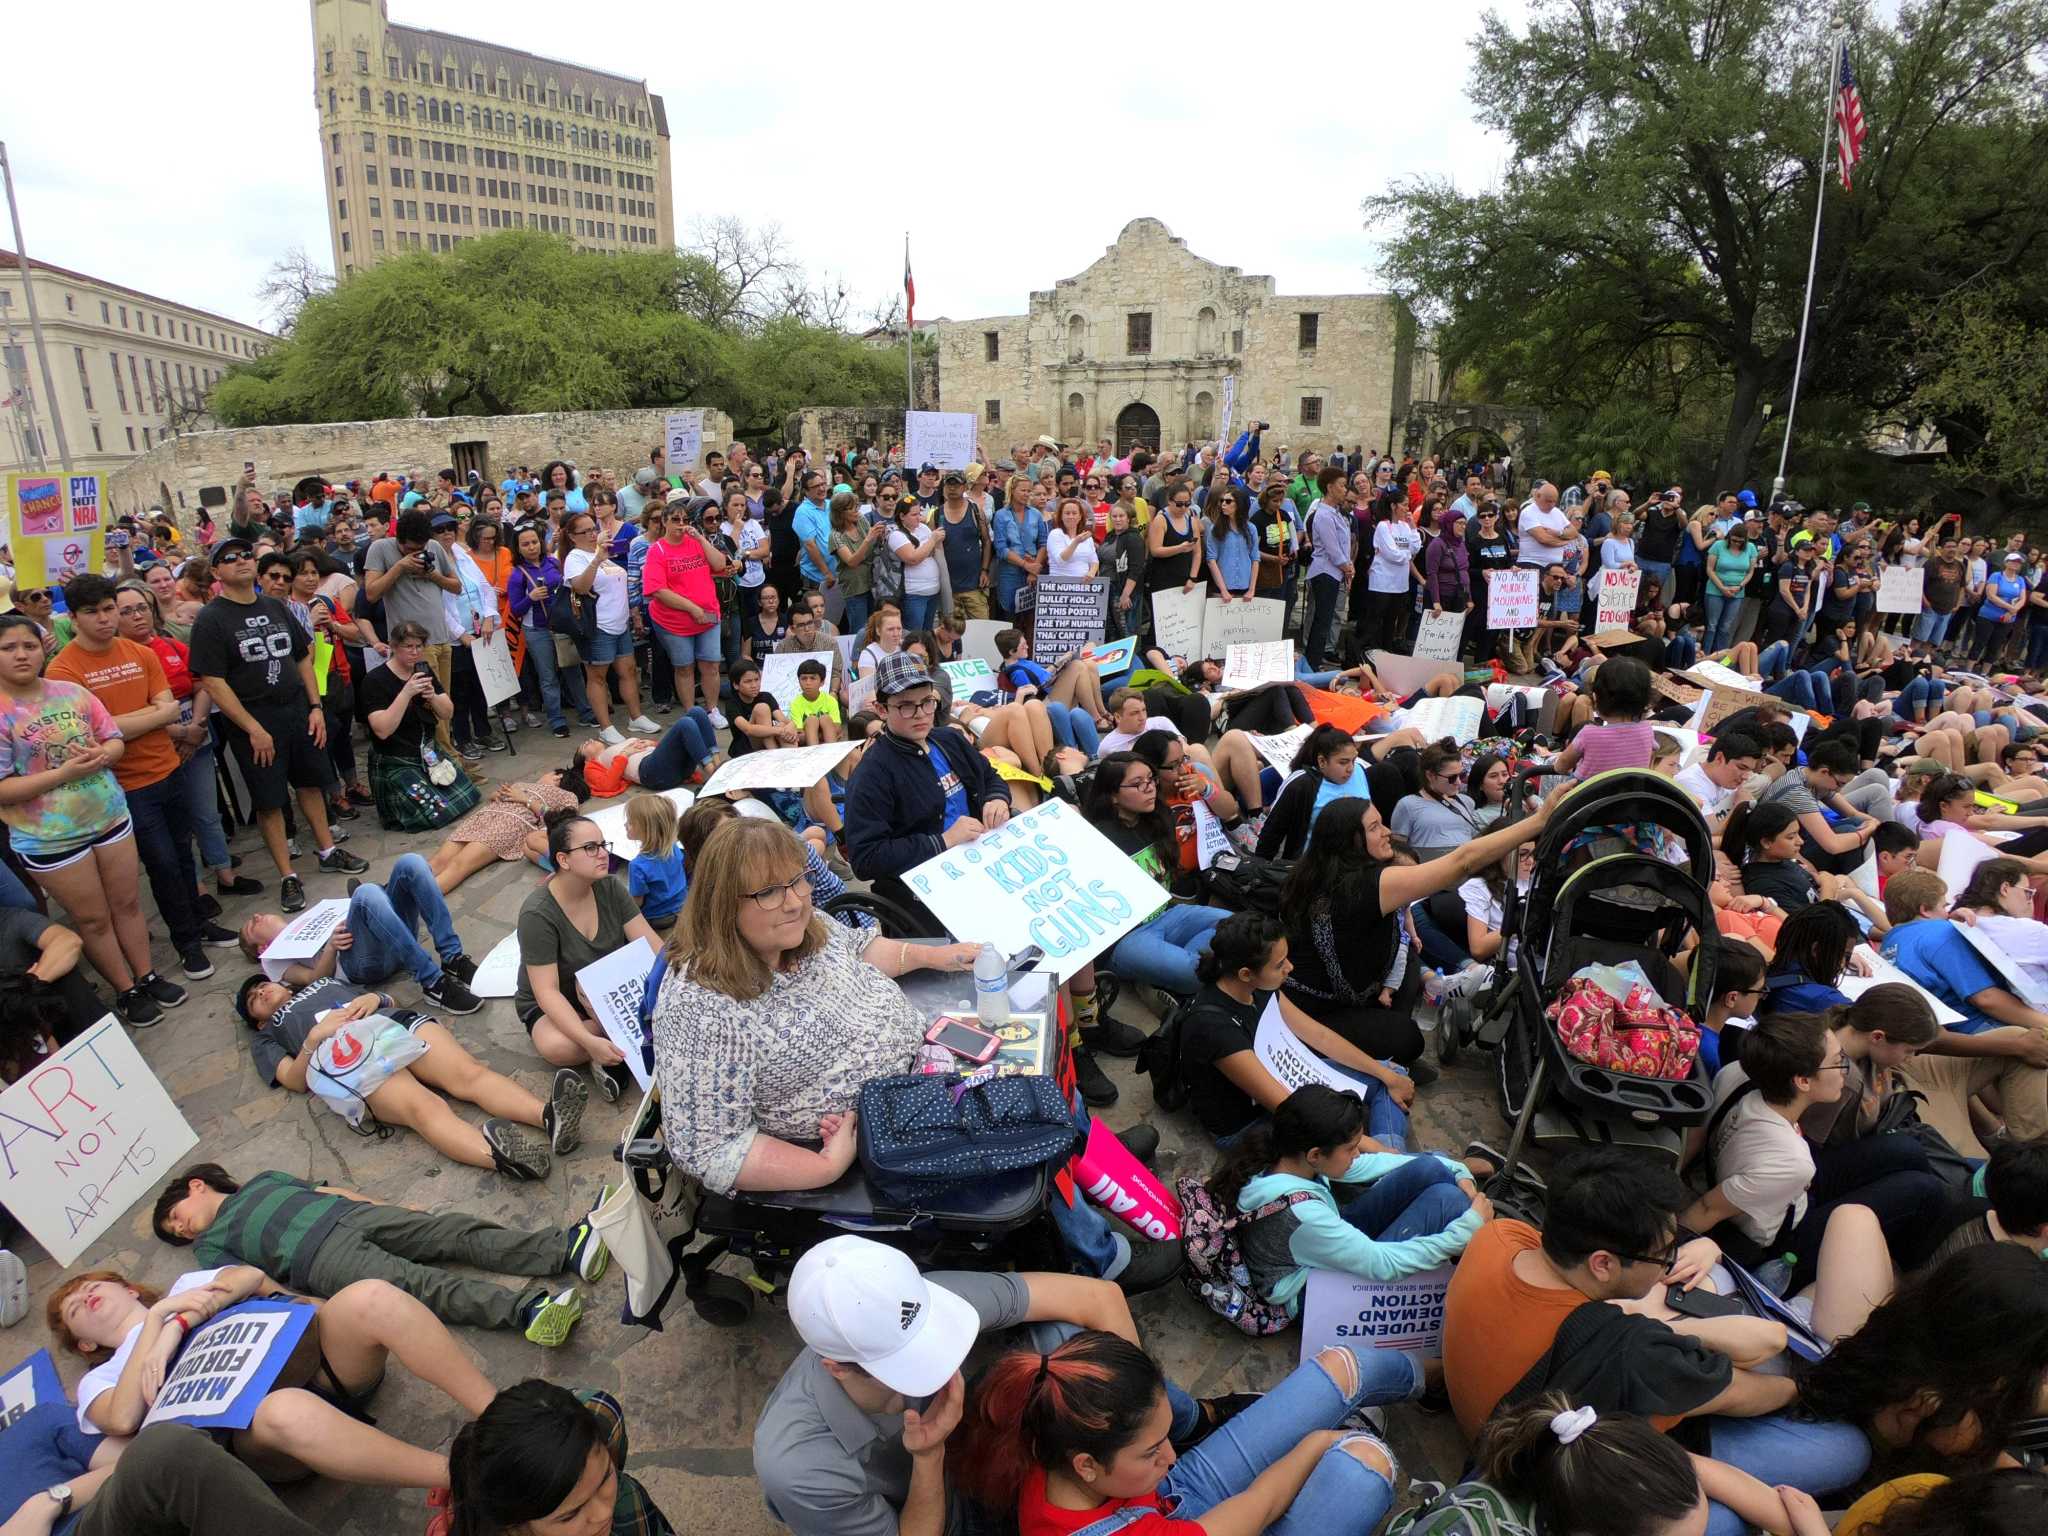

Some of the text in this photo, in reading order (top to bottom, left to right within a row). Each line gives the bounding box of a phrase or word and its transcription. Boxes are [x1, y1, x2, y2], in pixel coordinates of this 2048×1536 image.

[70, 476, 97, 497] PTA
[72, 496, 97, 506] NOT
[73, 506, 97, 526] NRA
[1495, 572, 1530, 581] NO MORE
[1605, 571, 1617, 586] NO
[1040, 583, 1103, 592] THE NUMBER OF
[1499, 583, 1527, 592] MURDER
[1039, 595, 1095, 604] BULLET HOLES
[1493, 595, 1534, 606] MOURNING
[1038, 607, 1098, 616] IN THIS POSTER
[1216, 604, 1272, 616] THOUGHTS
[1506, 608, 1519, 617] AND
[1600, 610, 1615, 623] END
[245, 615, 270, 628] GO
[1037, 619, 1104, 628] ARE THE NUMBER
[1492, 616, 1534, 627] MOVING ON
[234, 623, 289, 640] SPURS
[1037, 631, 1086, 640] THAT CAN BE
[239, 632, 292, 662] GO
[1035, 643, 1057, 651] SHOT
[1058, 643, 1068, 651] IN
[1035, 655, 1054, 663] TIME
[912, 802, 1061, 895] PROTECT
[985, 833, 1069, 894] KIDS
[1022, 868, 1076, 913] NOT
[1029, 879, 1132, 959] GUNS
[608, 990, 643, 1040] ACTION
[0, 1023, 124, 1180] ART
[55, 1112, 116, 1177] NOT
[65, 1128, 156, 1235] AR-15
[1087, 1172, 1139, 1213] All
[1352, 1284, 1385, 1292] AMERICA
[1393, 1284, 1417, 1292] SENSE
[1371, 1292, 1447, 1308] ACTION
[901, 1302, 921, 1330] adidas
[1358, 1306, 1445, 1322] DEMAND
[207, 1321, 269, 1349] LIVES
[1335, 1320, 1441, 1337] STUDENTS
[201, 1348, 253, 1374] FOR
[155, 1375, 236, 1410] MARCH
